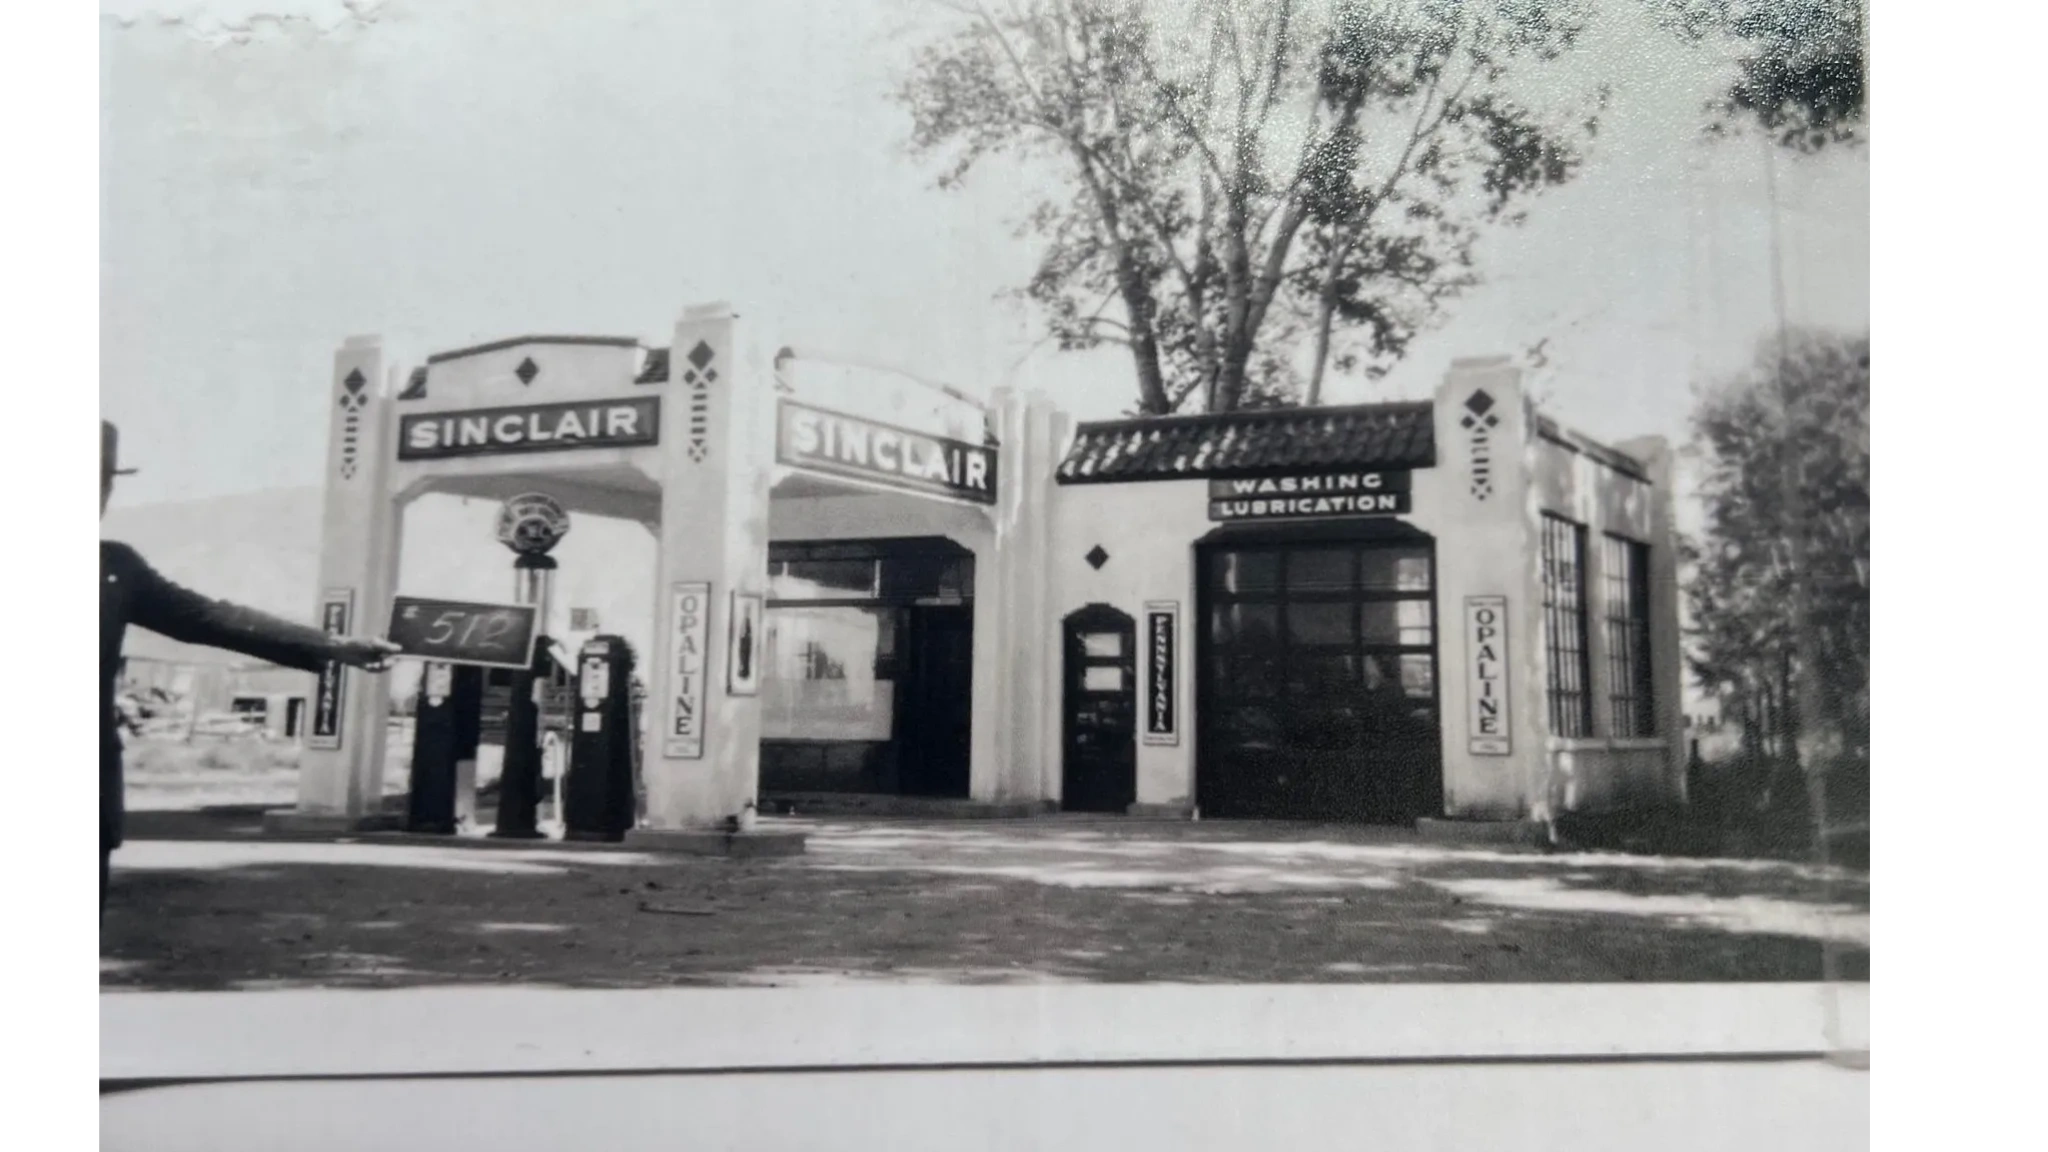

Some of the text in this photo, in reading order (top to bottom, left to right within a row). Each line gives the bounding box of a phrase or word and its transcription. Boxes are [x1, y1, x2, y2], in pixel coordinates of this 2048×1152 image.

[409, 406, 638, 448] SINCLAIR
[791, 410, 987, 490] SINCLAIR
[1220, 494, 1397, 516] LUBRICATION
[1232, 472, 1383, 494] WASHING
[674, 595, 698, 736] OPALINE
[1154, 615, 1167, 731] PENNSYLVANIA
[1475, 608, 1498, 734] OPALINE
